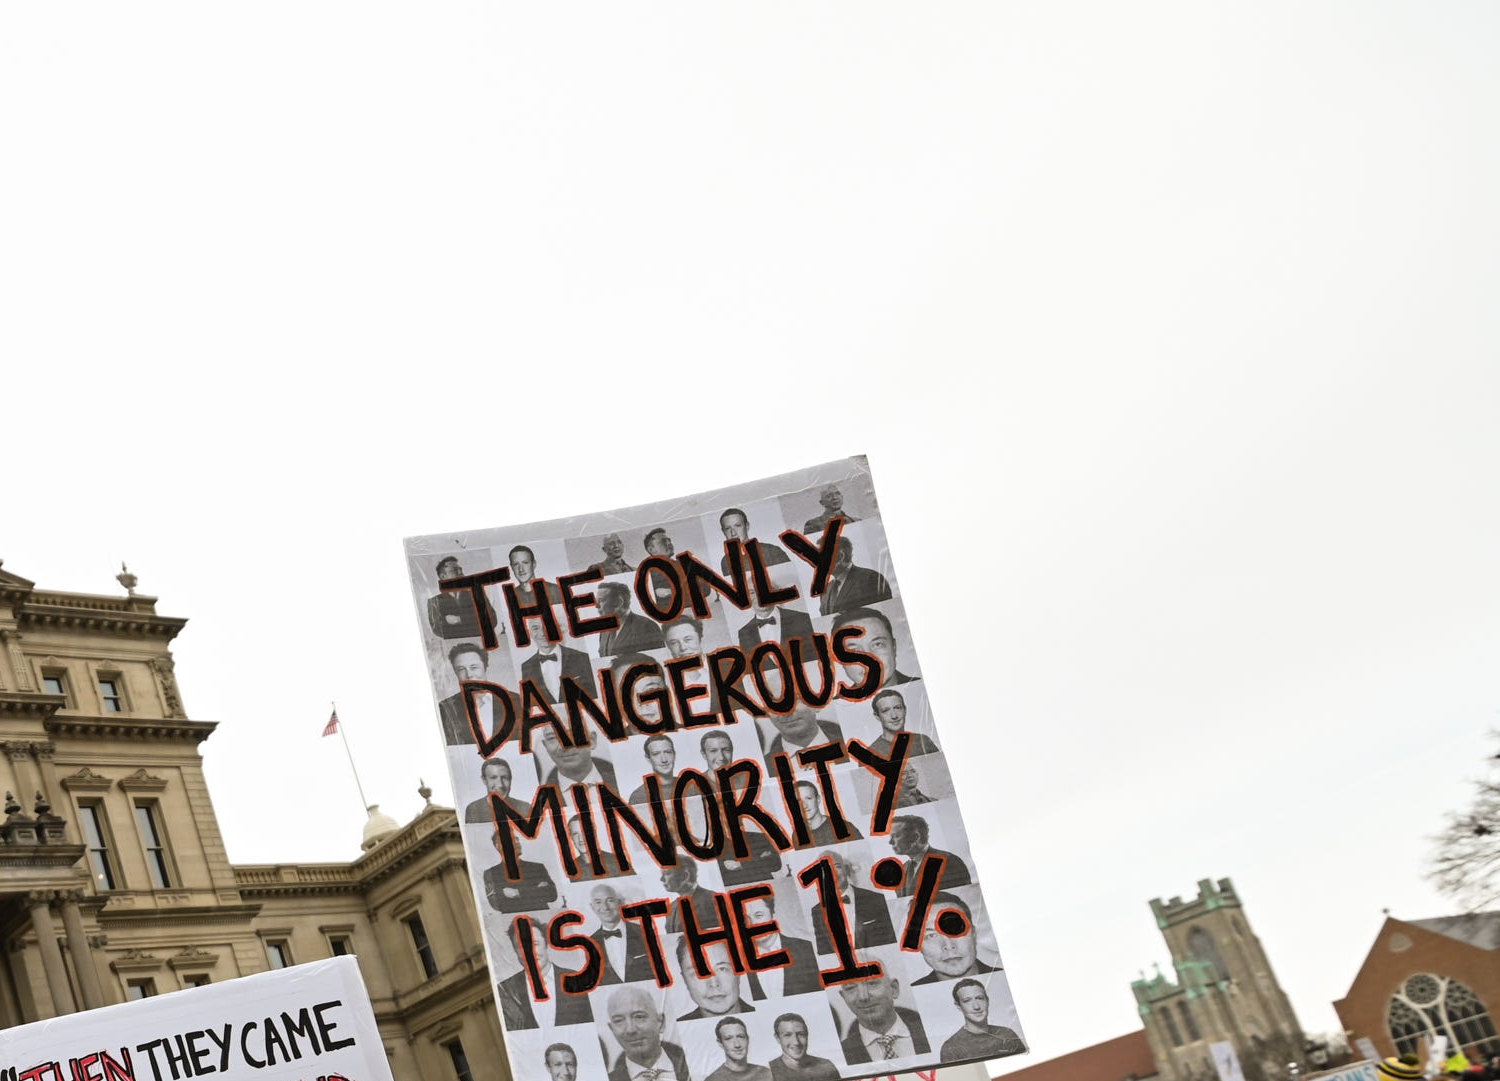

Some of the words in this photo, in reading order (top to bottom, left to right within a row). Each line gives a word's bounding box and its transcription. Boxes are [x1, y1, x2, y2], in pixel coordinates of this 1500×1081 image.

[438, 565, 619, 652] THE
[632, 516, 846, 625] ONLY
[458, 626, 883, 759] DANGEROUS
[486, 731, 912, 882] MINORITY
[510, 910, 602, 1002] IS
[621, 884, 793, 988] THE
[798, 853, 972, 988] 1%
[240, 1000, 356, 1069] CAME
